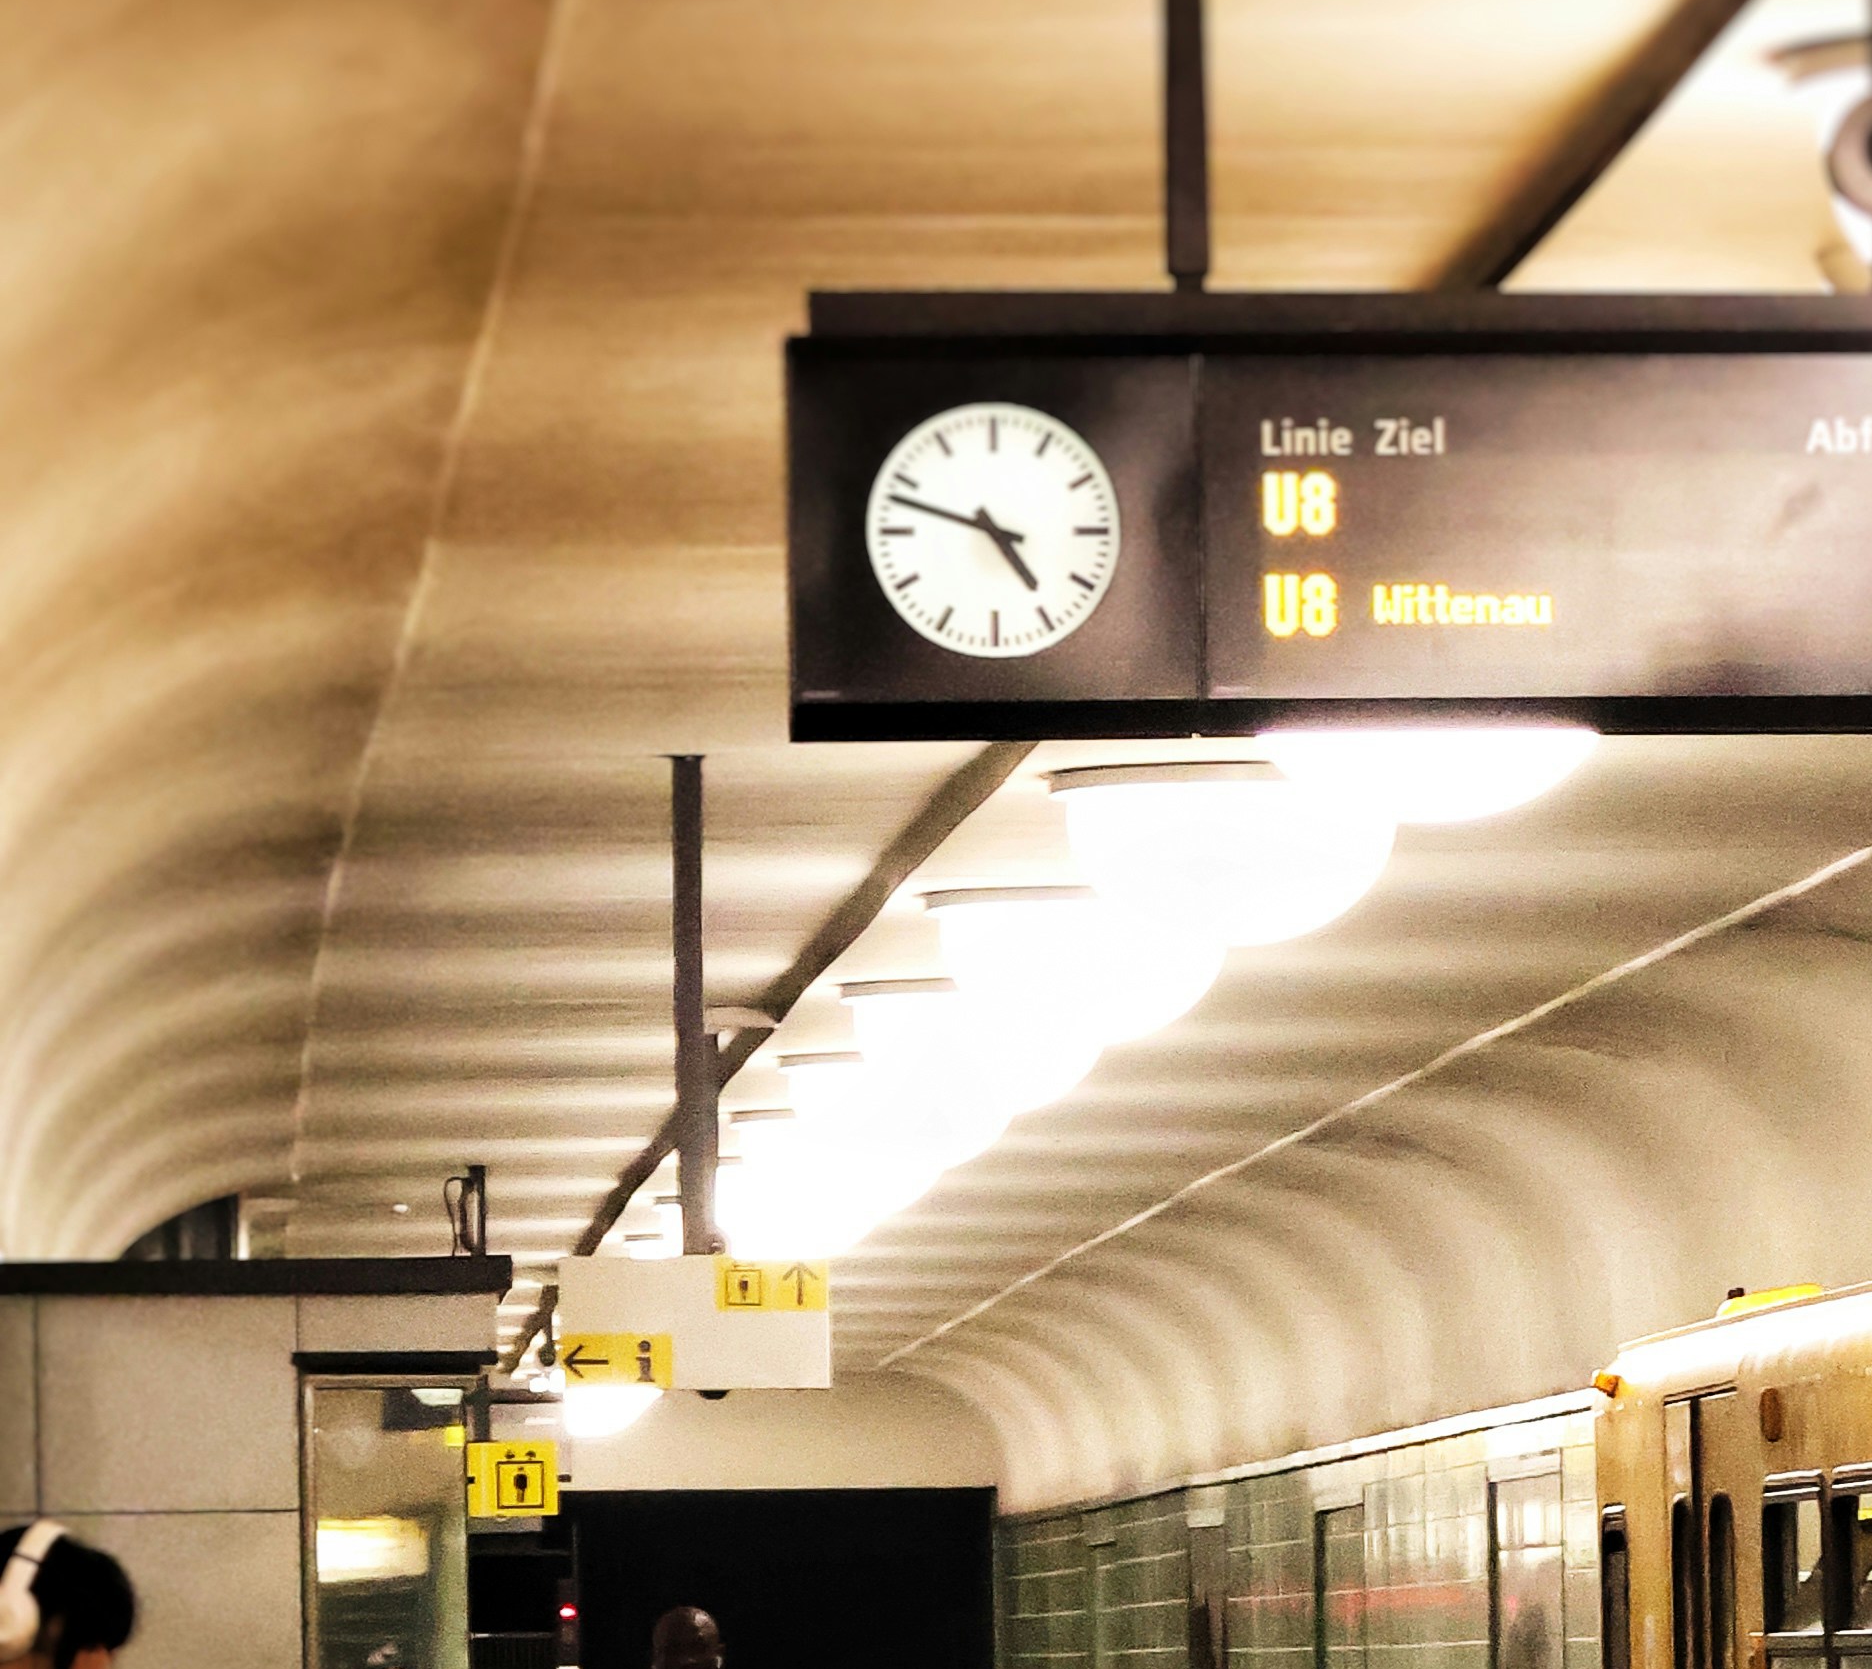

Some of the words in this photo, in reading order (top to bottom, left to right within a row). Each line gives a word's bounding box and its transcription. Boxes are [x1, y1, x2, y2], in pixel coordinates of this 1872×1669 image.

[1260, 416, 1353, 456] Linie
[1373, 414, 1446, 456] Ziel
[1261, 469, 1337, 537] U8
[1263, 573, 1339, 638] U8
[1372, 583, 1553, 626] Wittenau
